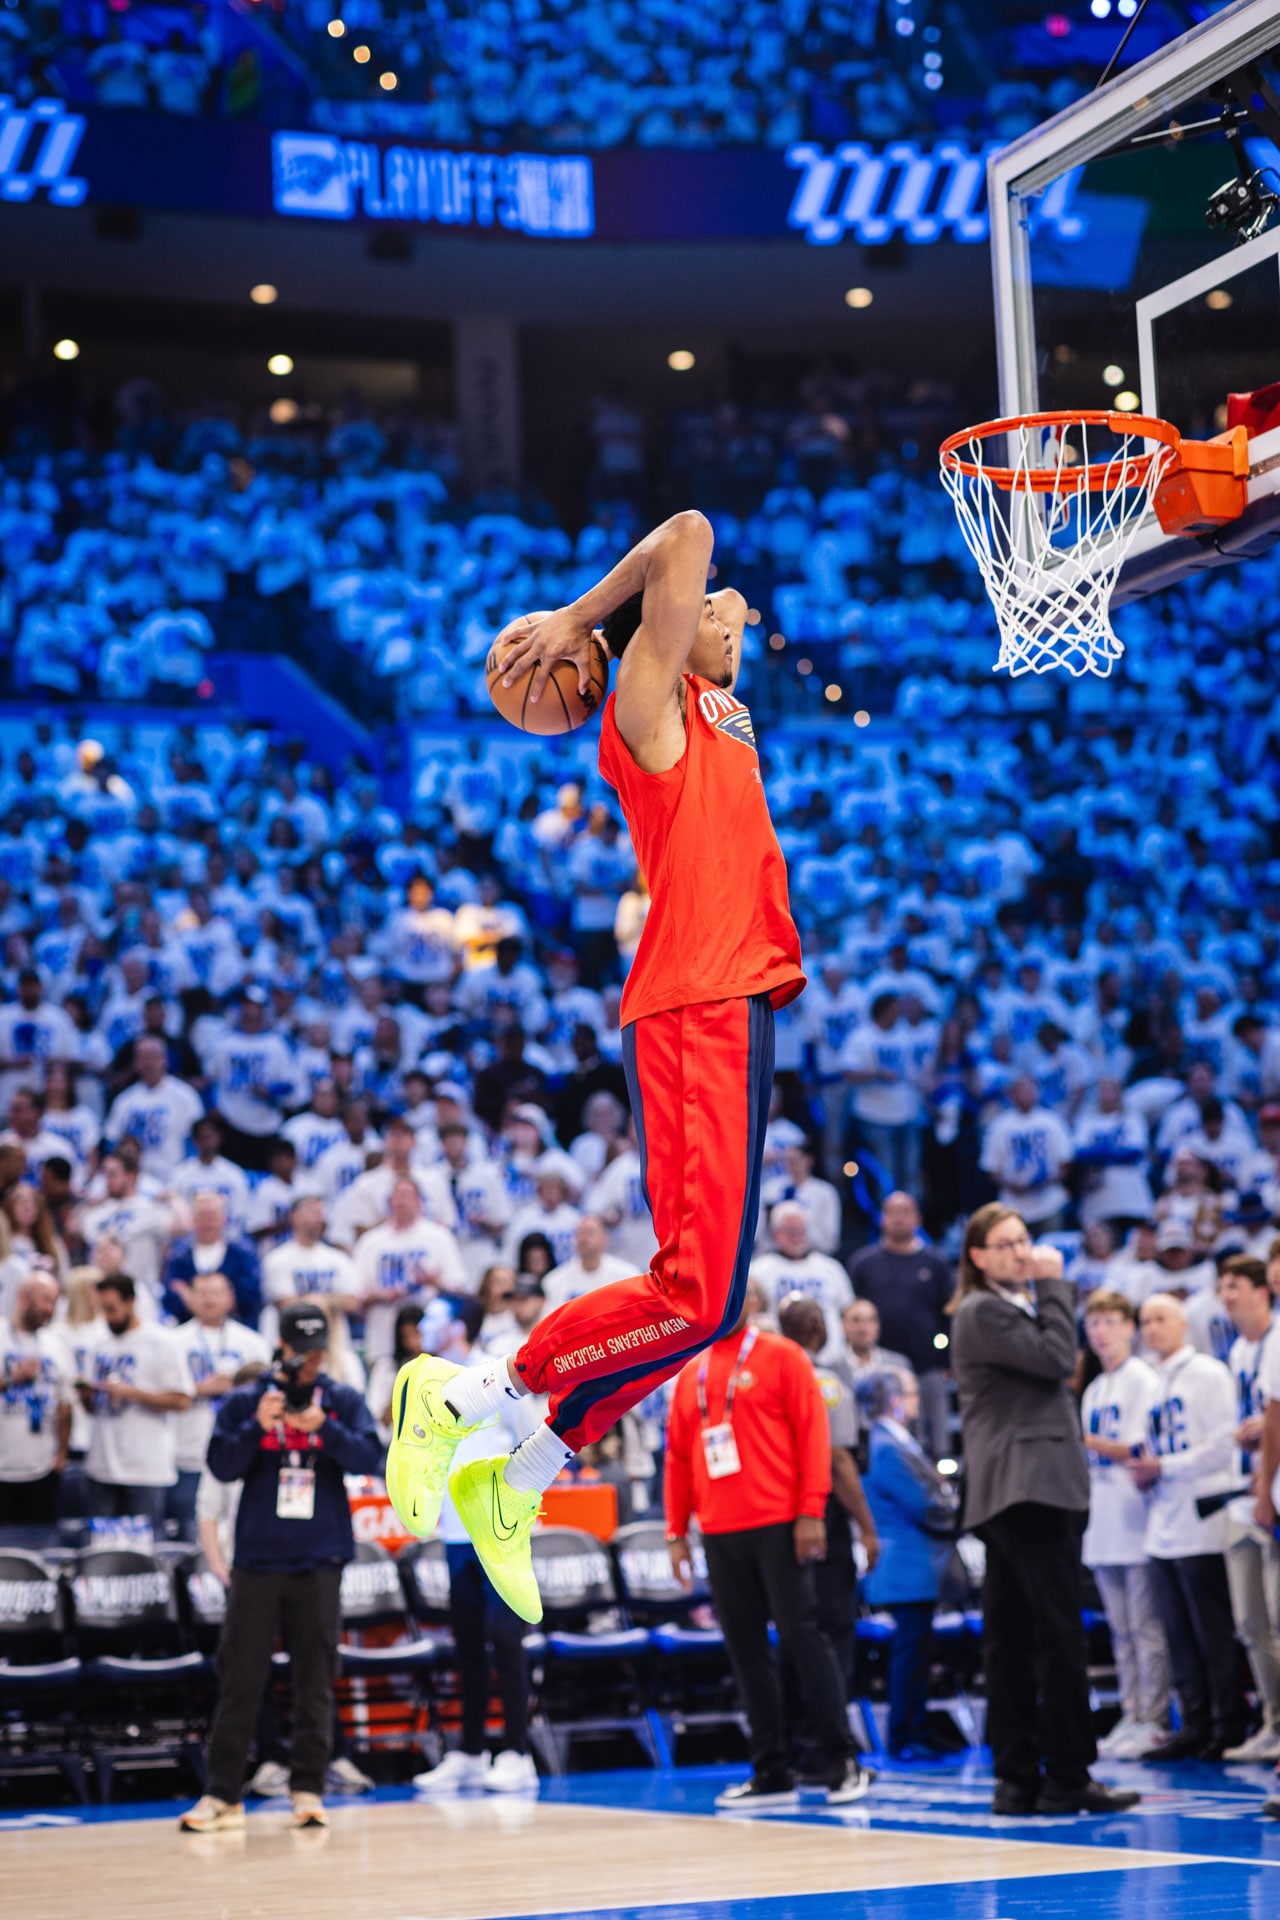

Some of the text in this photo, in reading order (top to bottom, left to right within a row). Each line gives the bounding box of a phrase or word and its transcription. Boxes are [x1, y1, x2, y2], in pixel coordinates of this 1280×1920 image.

[338, 140, 524, 230] PLAYOFFS
[553, 1316, 691, 1374] NEW ORLEANS PELICANS
